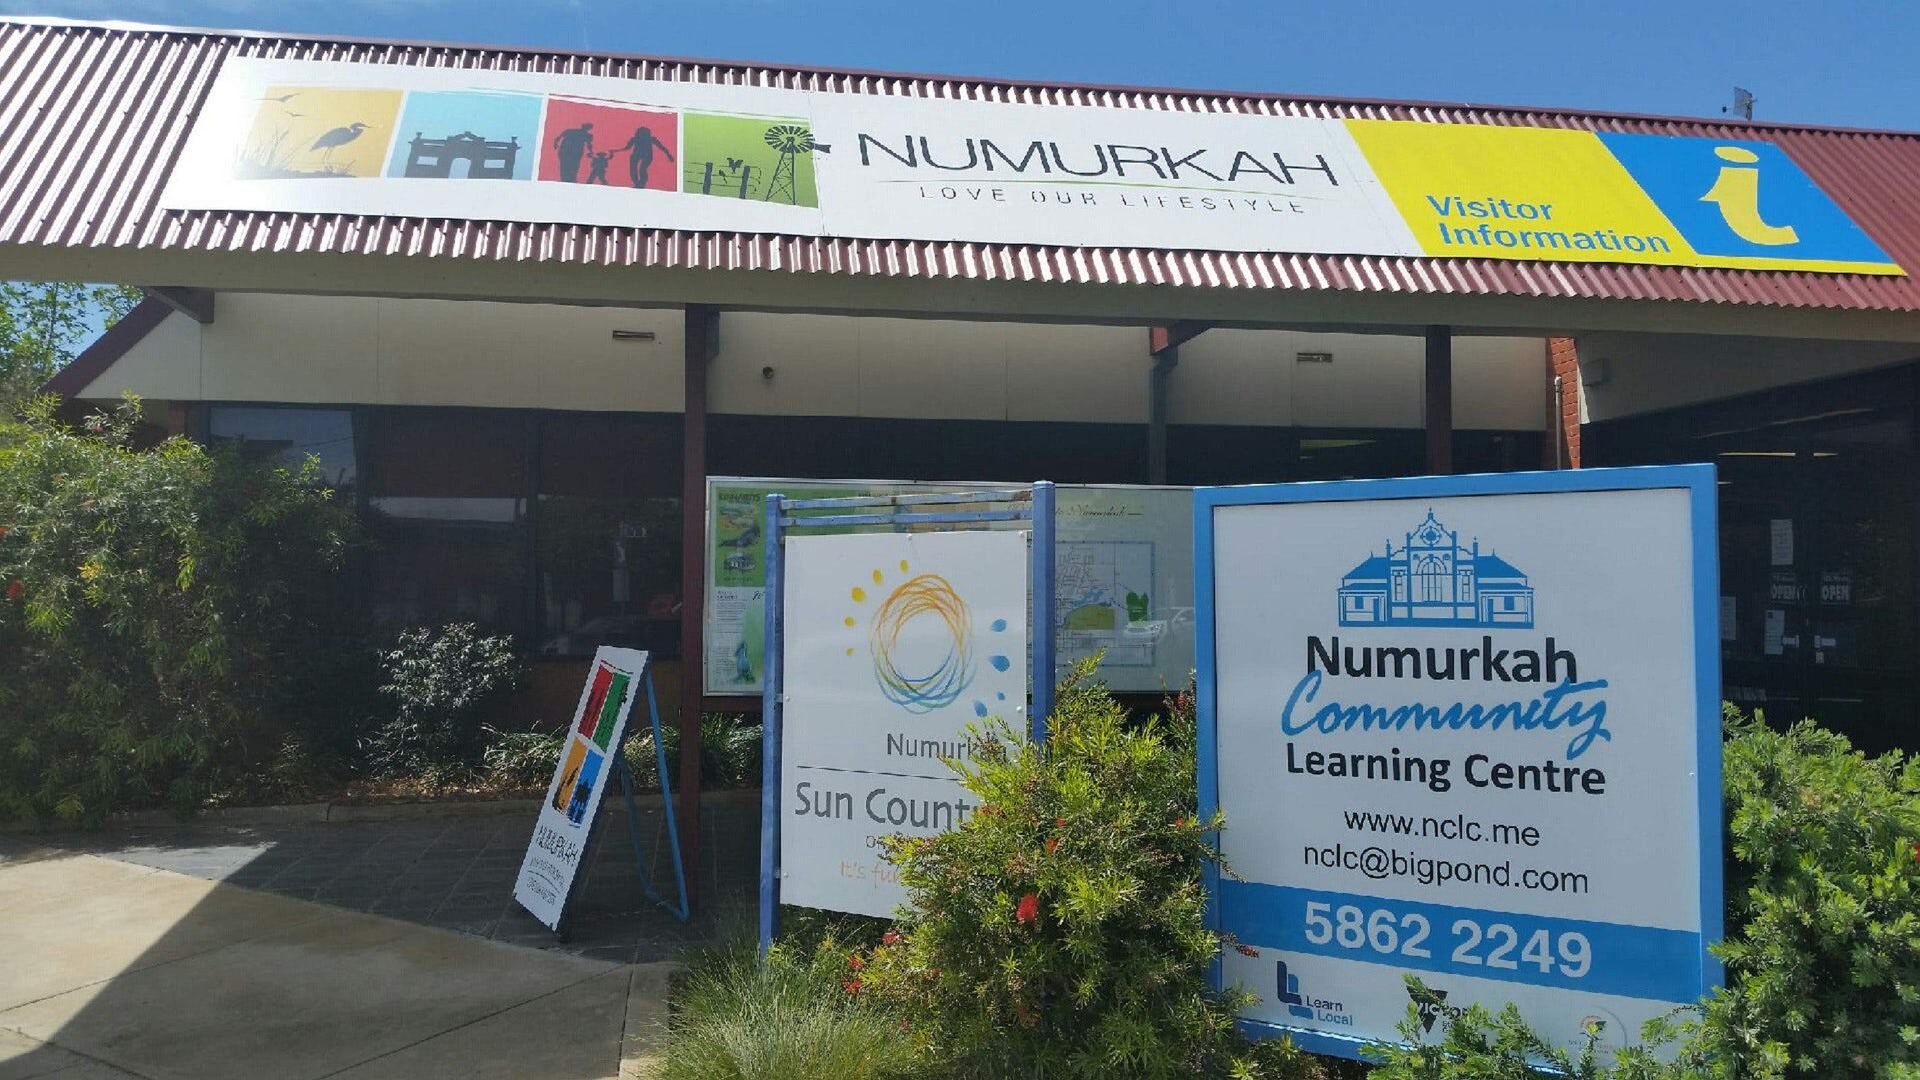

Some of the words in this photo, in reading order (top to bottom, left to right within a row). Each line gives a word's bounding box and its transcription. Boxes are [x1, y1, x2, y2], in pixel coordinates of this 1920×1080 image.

[858, 133, 1339, 186] NUMURKAH
[920, 186, 1007, 202] LOVE
[1031, 190, 1096, 206] OUR
[1121, 194, 1305, 213] LIFESTYLE
[1426, 195, 1553, 221] Visitor
[1440, 222, 1671, 253] Information
[1821, 584, 1849, 600] OPEN
[1306, 635, 1578, 684] Numurkah
[1281, 670, 1611, 760] Community
[1286, 743, 1451, 792] Learning
[1464, 753, 1607, 795] Centre
[794, 781, 853, 820] Sun
[865, 788, 973, 829] Count
[1344, 810, 1540, 847] www.nclc.me
[1304, 844, 1589, 893] nclc@bigpond.com
[1304, 900, 1432, 959] 5862
[1450, 918, 1592, 978] 2249
[1306, 995, 1343, 1012] Learn
[1317, 1009, 1354, 1027] Local
